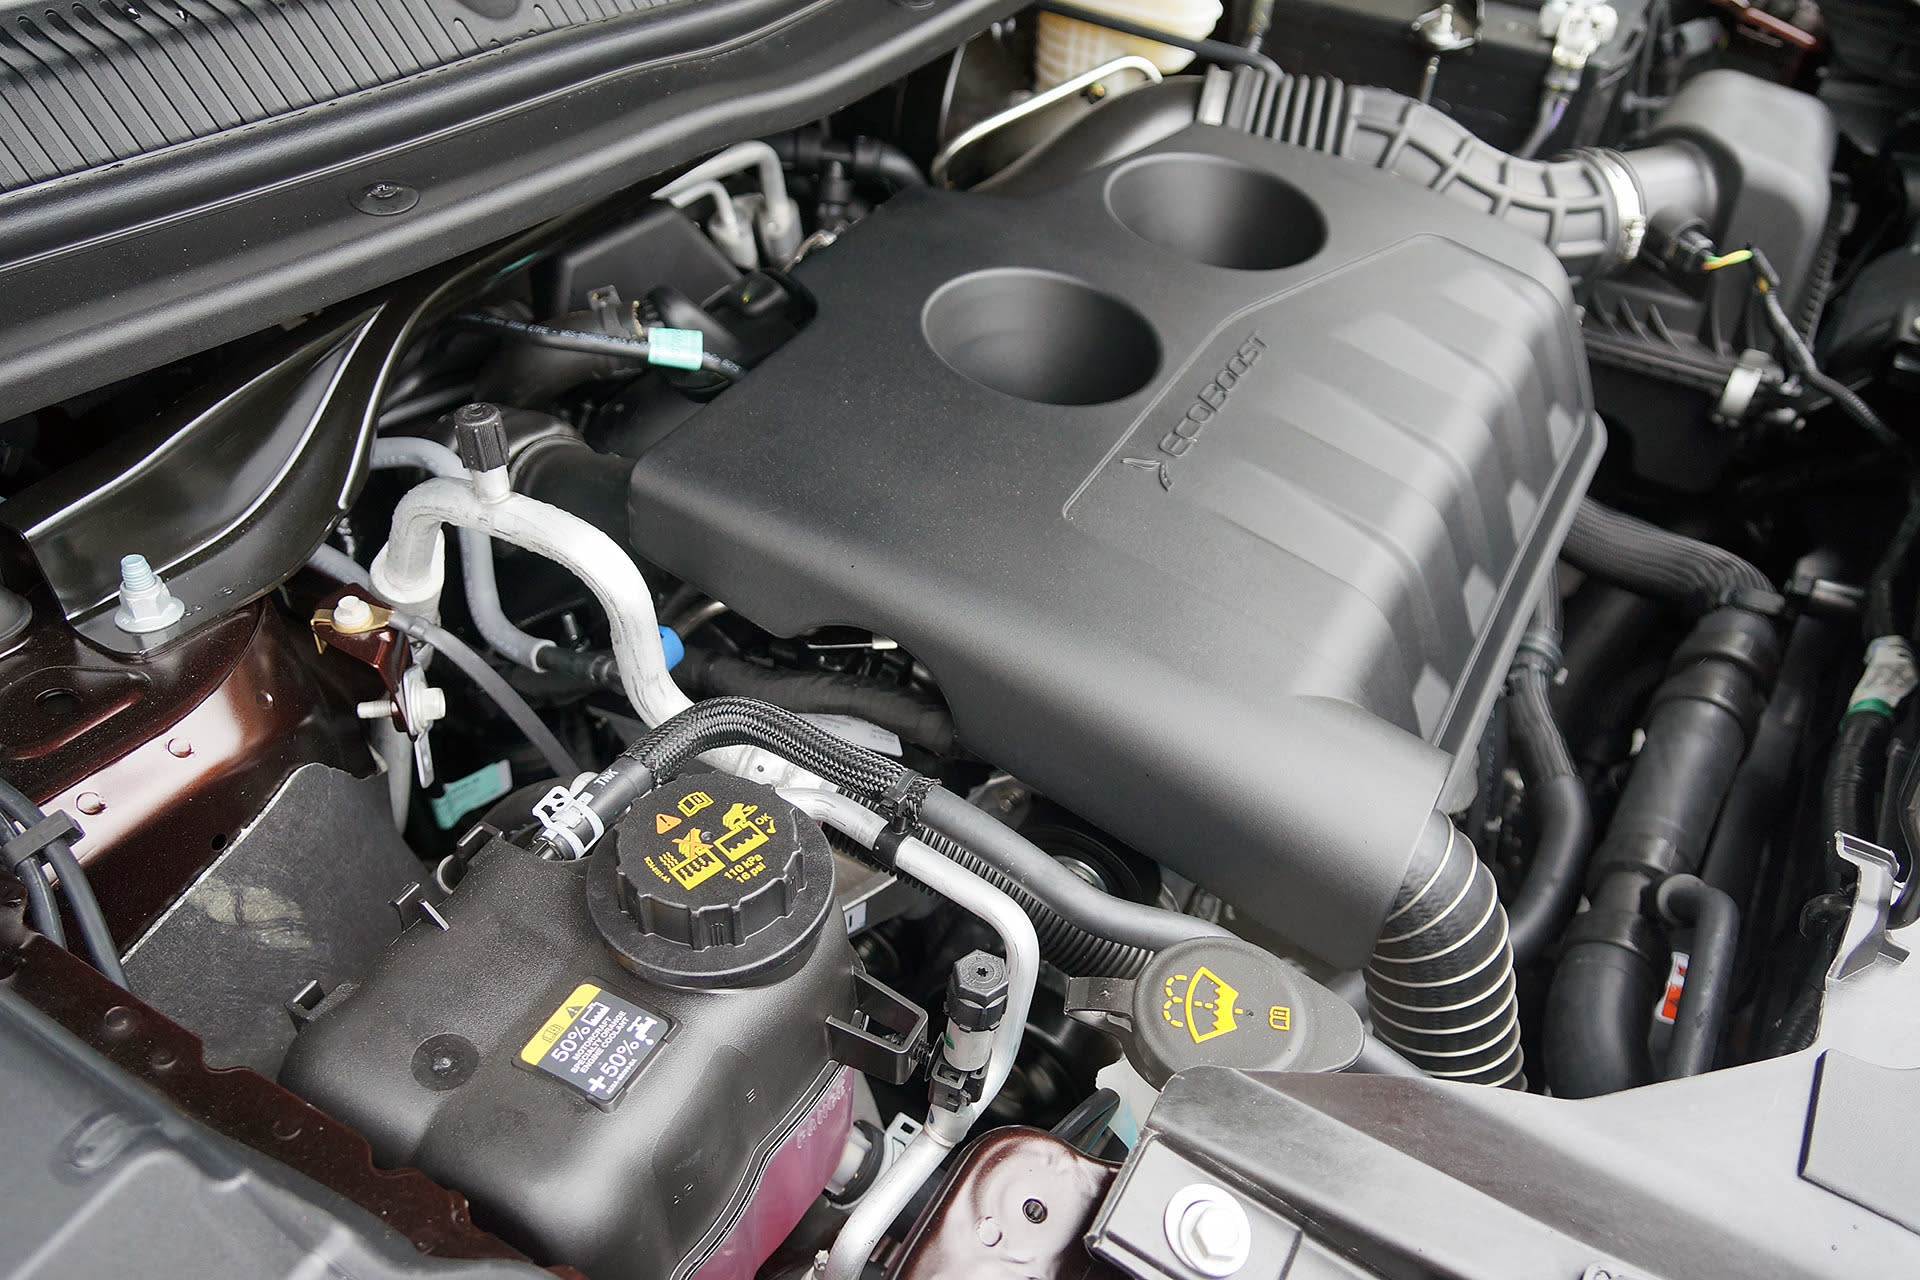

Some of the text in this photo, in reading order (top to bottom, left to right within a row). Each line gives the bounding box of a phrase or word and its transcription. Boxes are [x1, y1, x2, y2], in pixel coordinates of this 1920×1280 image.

[754, 812, 772, 826] OK
[724, 854, 764, 880] 110 kPa
[750, 862, 767, 877] psi
[551, 1026, 591, 1062] 50%
[570, 1038, 602, 1074] SPECIALTY
[600, 1010, 627, 1039] ORANGE
[572, 1016, 612, 1060] MOTORCRAFT
[579, 1048, 605, 1074] ENGINE
[601, 1016, 630, 1048] COOLANT
